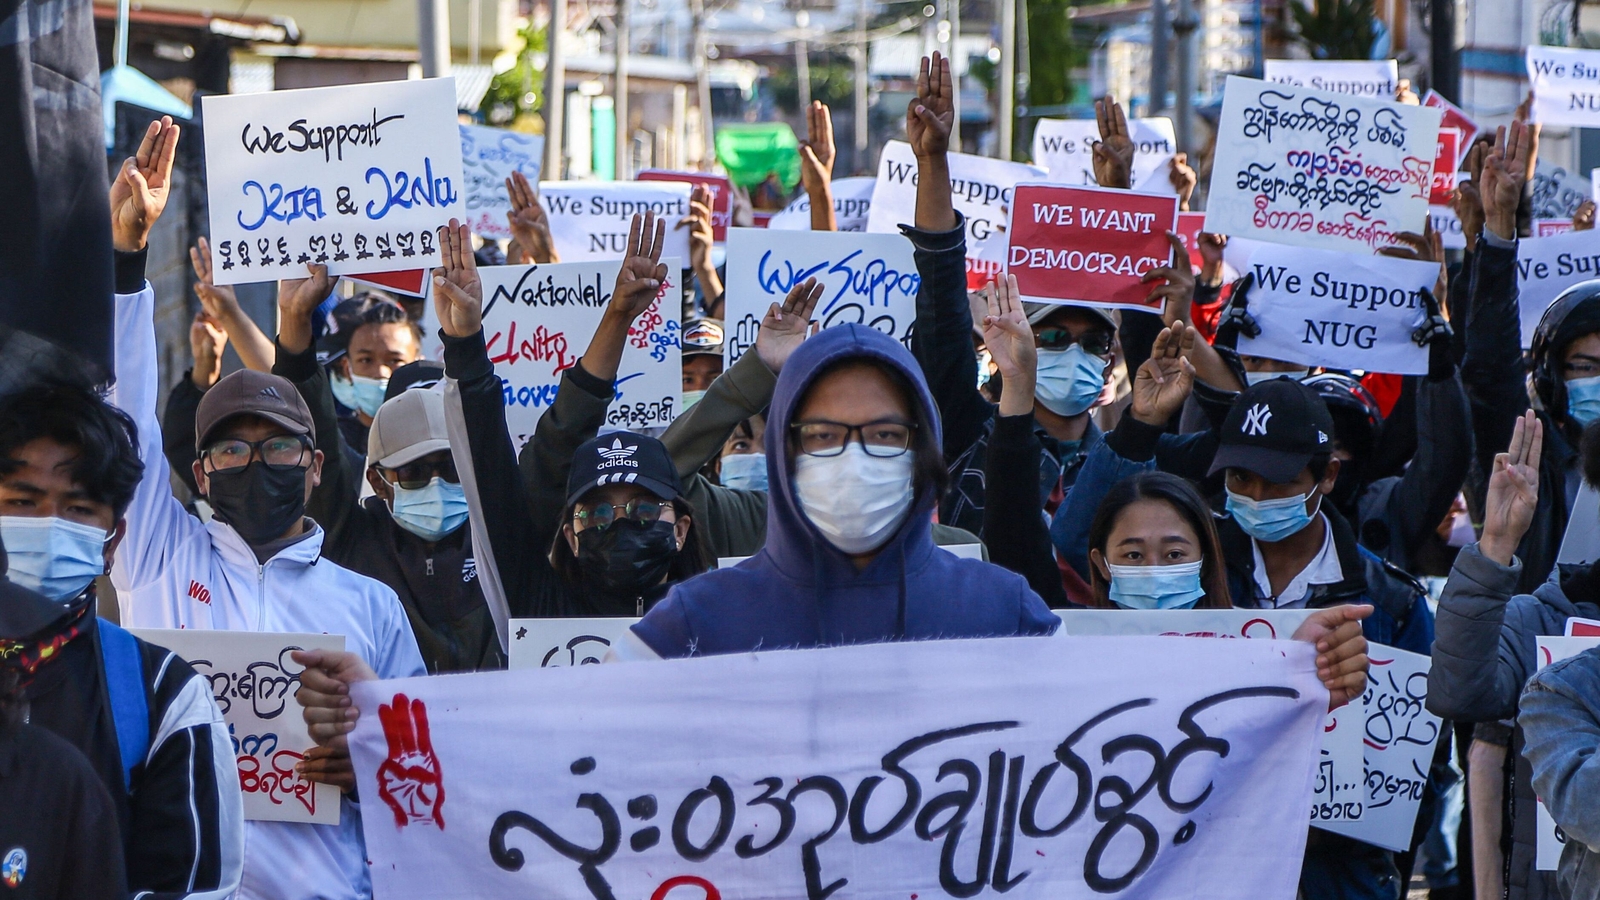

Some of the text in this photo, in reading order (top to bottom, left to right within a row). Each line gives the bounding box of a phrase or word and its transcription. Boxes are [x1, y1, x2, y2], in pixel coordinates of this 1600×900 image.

[1533, 58, 1566, 79] We
[242, 107, 405, 163] We Support
[1041, 135, 1170, 155] We Sort
[887, 159, 1012, 206] We uppo
[336, 186, 358, 215] &
[546, 196, 582, 215] We
[590, 195, 684, 221] Support
[1032, 203, 1156, 234] WE WANT
[589, 233, 628, 253] NU
[758, 248, 922, 316] We Suppor
[1253, 264, 1425, 311] We Suppor
[1302, 319, 1378, 349] NUG
[596, 457, 639, 470] adidas
